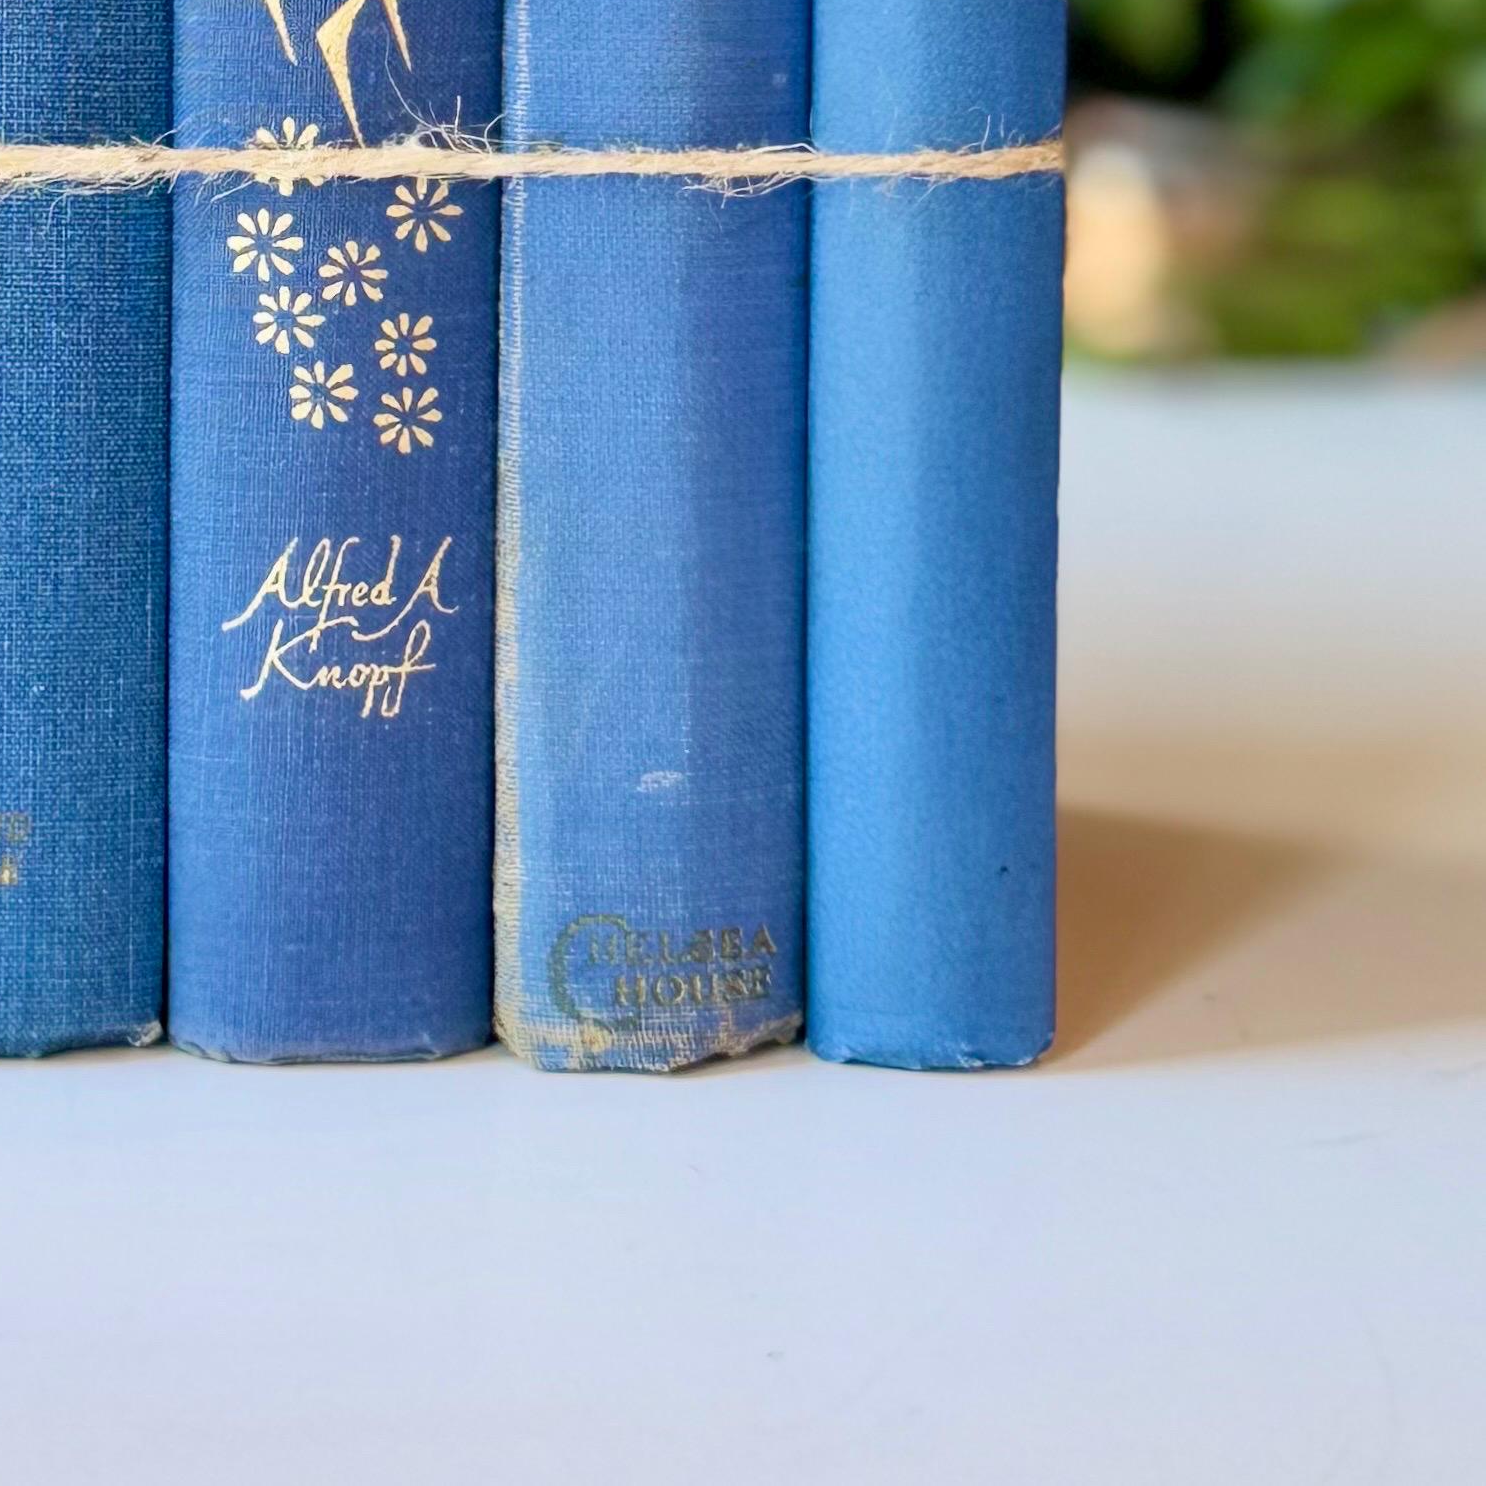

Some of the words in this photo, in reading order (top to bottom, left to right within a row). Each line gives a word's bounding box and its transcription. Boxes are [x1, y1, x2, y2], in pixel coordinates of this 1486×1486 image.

[220, 534, 398, 653] Alfred
[350, 535, 460, 642] A
[239, 616, 437, 719] Knopf
